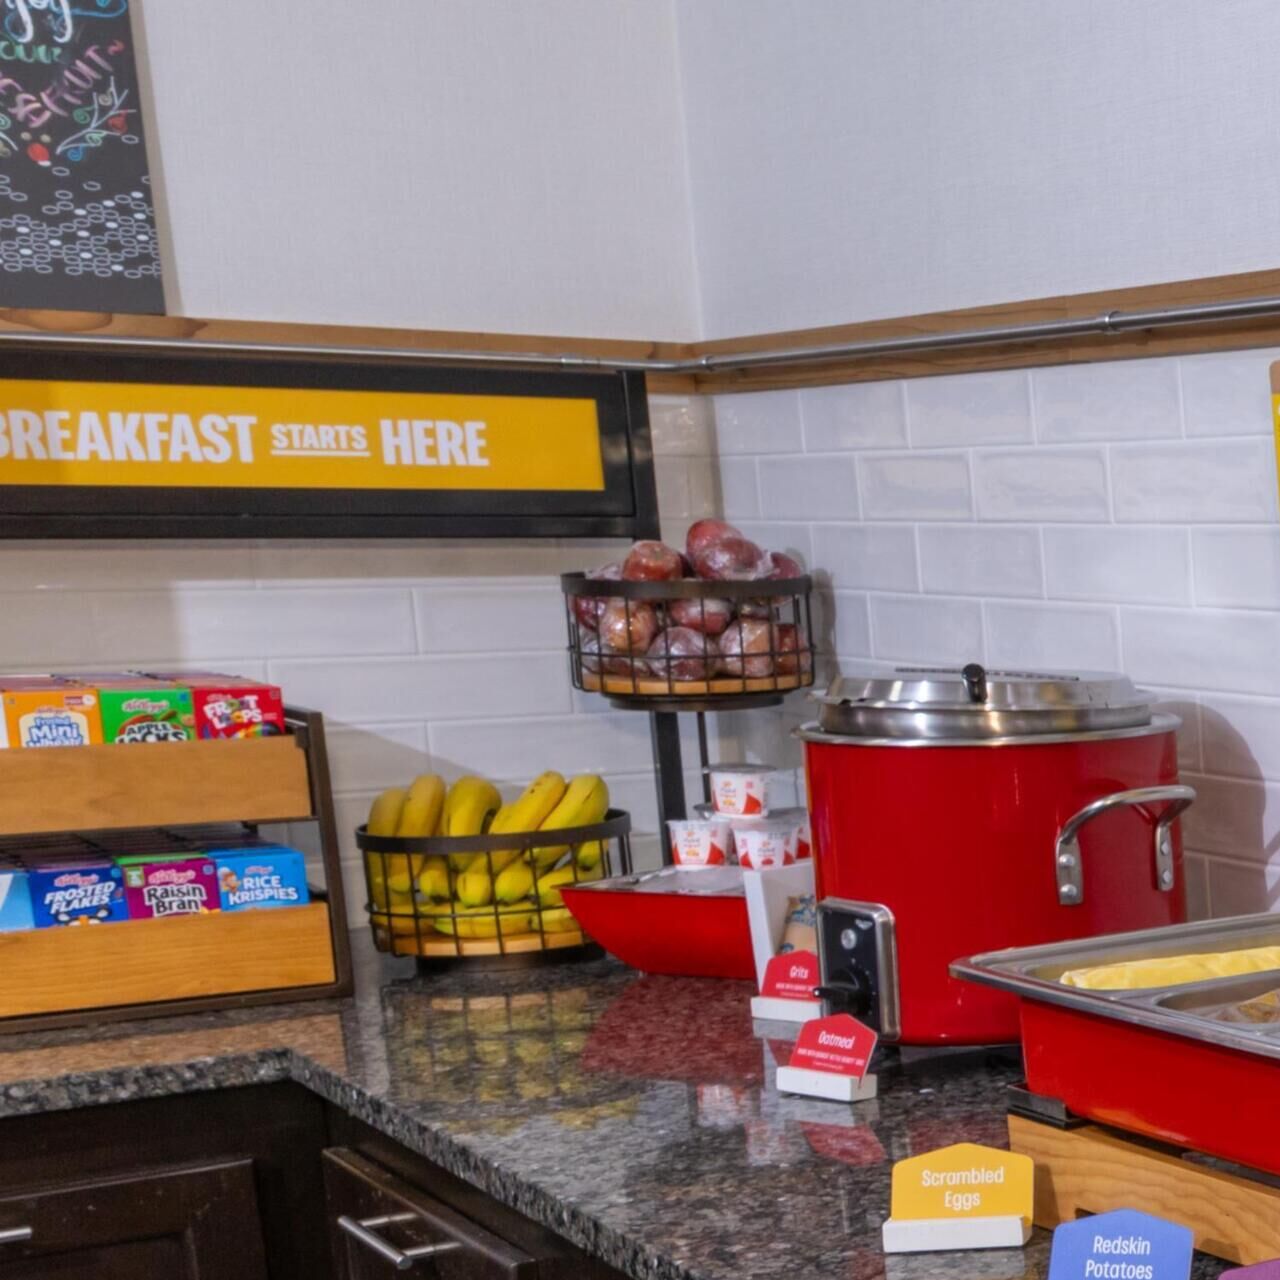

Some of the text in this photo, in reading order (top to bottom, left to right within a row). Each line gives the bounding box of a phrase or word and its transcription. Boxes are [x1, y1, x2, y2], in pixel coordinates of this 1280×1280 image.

[0, 409, 489, 466] REAKFAST STARTS HERE
[31, 722, 78, 741] Mini
[127, 723, 171, 736] APPLE
[242, 875, 281, 890] RICE
[45, 881, 116, 904] FROSTED
[145, 885, 205, 904] Raisin
[229, 887, 298, 905] KRISPIES
[50, 893, 111, 914] FLAKES
[154, 899, 200, 916] Bran
[789, 965, 809, 979] Grits
[818, 1031, 856, 1049] Oatmeal
[921, 1167, 1005, 1188] Scrambled
[944, 1191, 981, 1211] Eggs
[1093, 1236, 1151, 1257] Redskin
[1085, 1260, 1153, 1280] Potatoes
